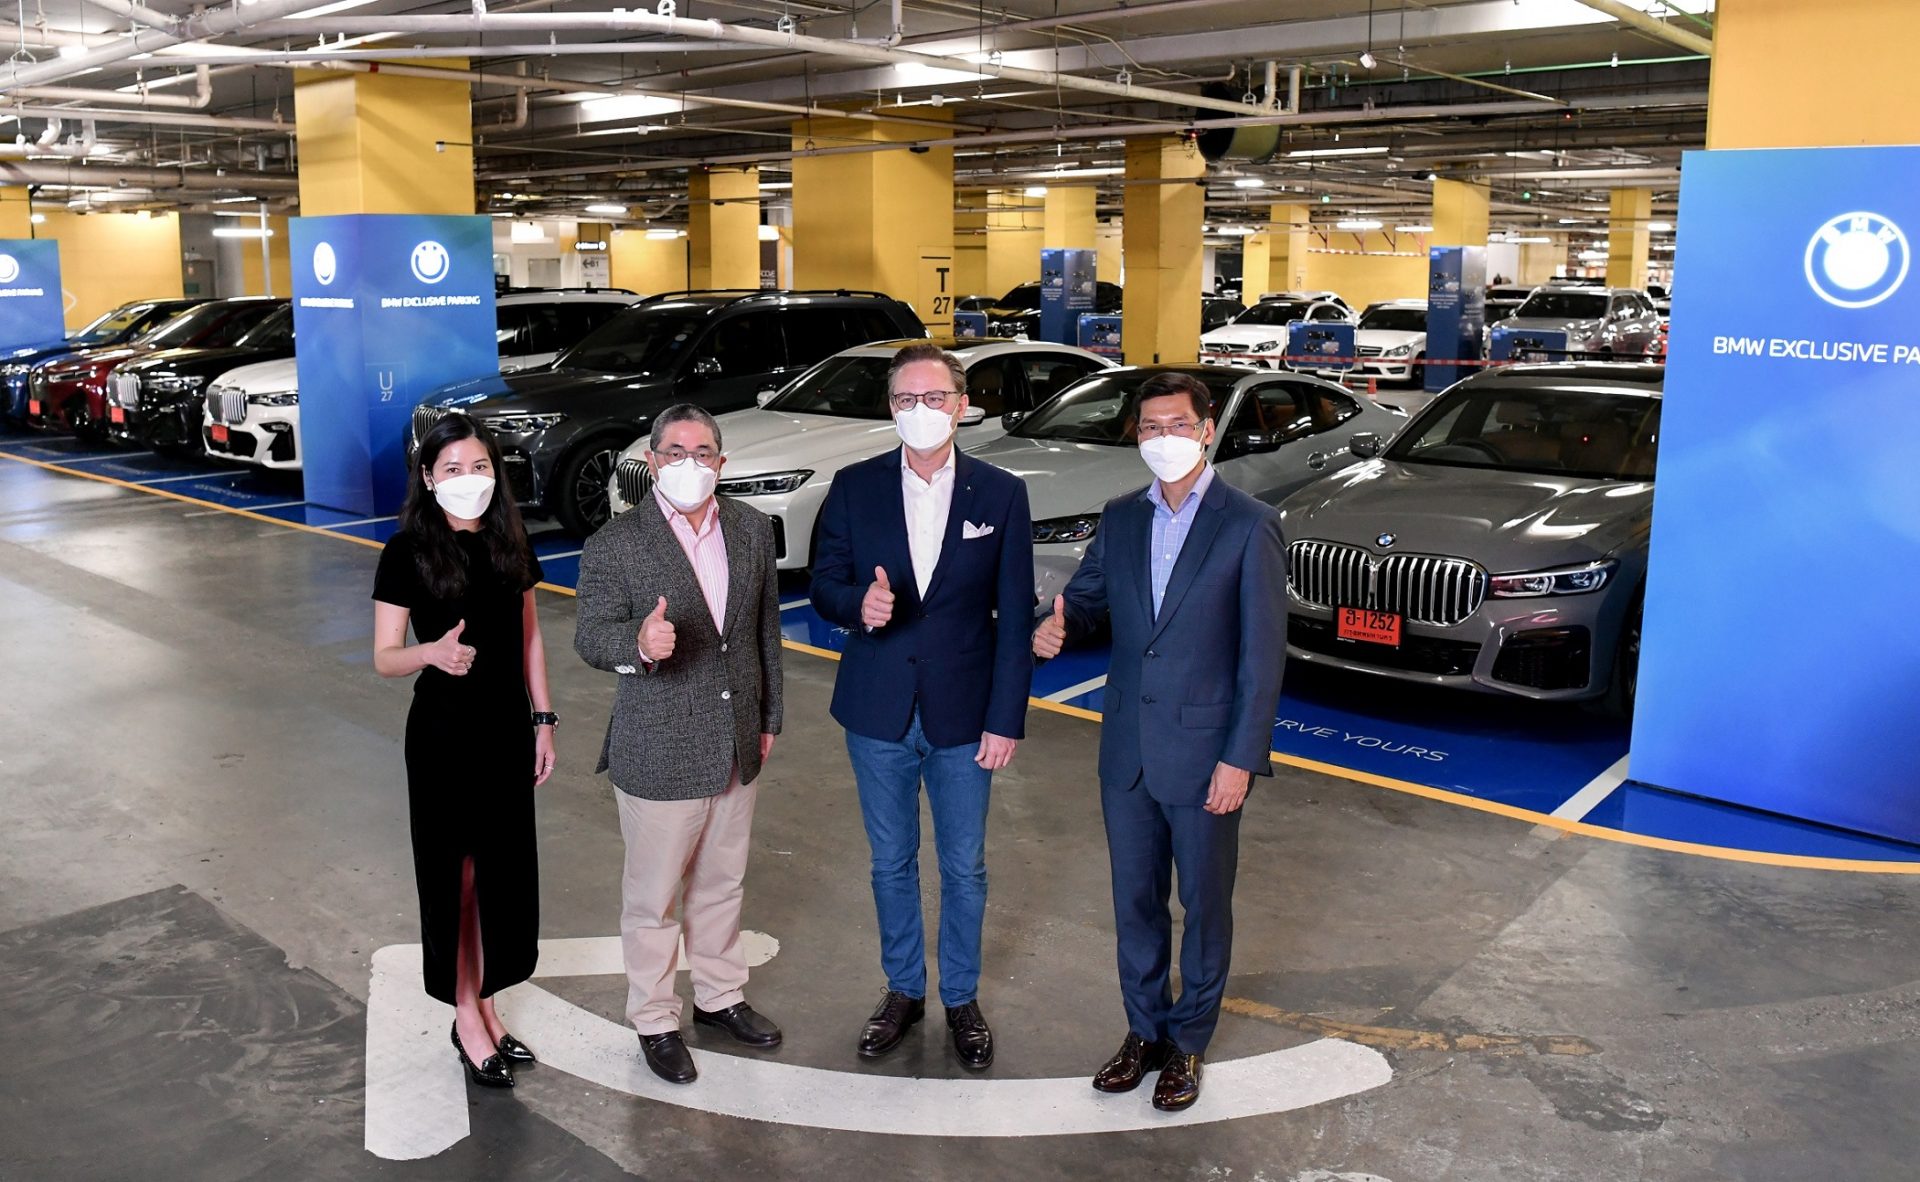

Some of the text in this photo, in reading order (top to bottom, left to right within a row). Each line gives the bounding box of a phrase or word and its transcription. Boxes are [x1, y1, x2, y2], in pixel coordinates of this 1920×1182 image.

[936, 268, 950, 292] T
[381, 295, 481, 308] BMW EXCLUSIVE PARKING
[933, 296, 951, 314] 27
[1713, 336, 1766, 356] BMW
[1769, 338, 1889, 363] EXCLUSIVE
[379, 371, 393, 390] U
[381, 391, 393, 402] 27
[1275, 717, 1449, 762] RVE YOURS
